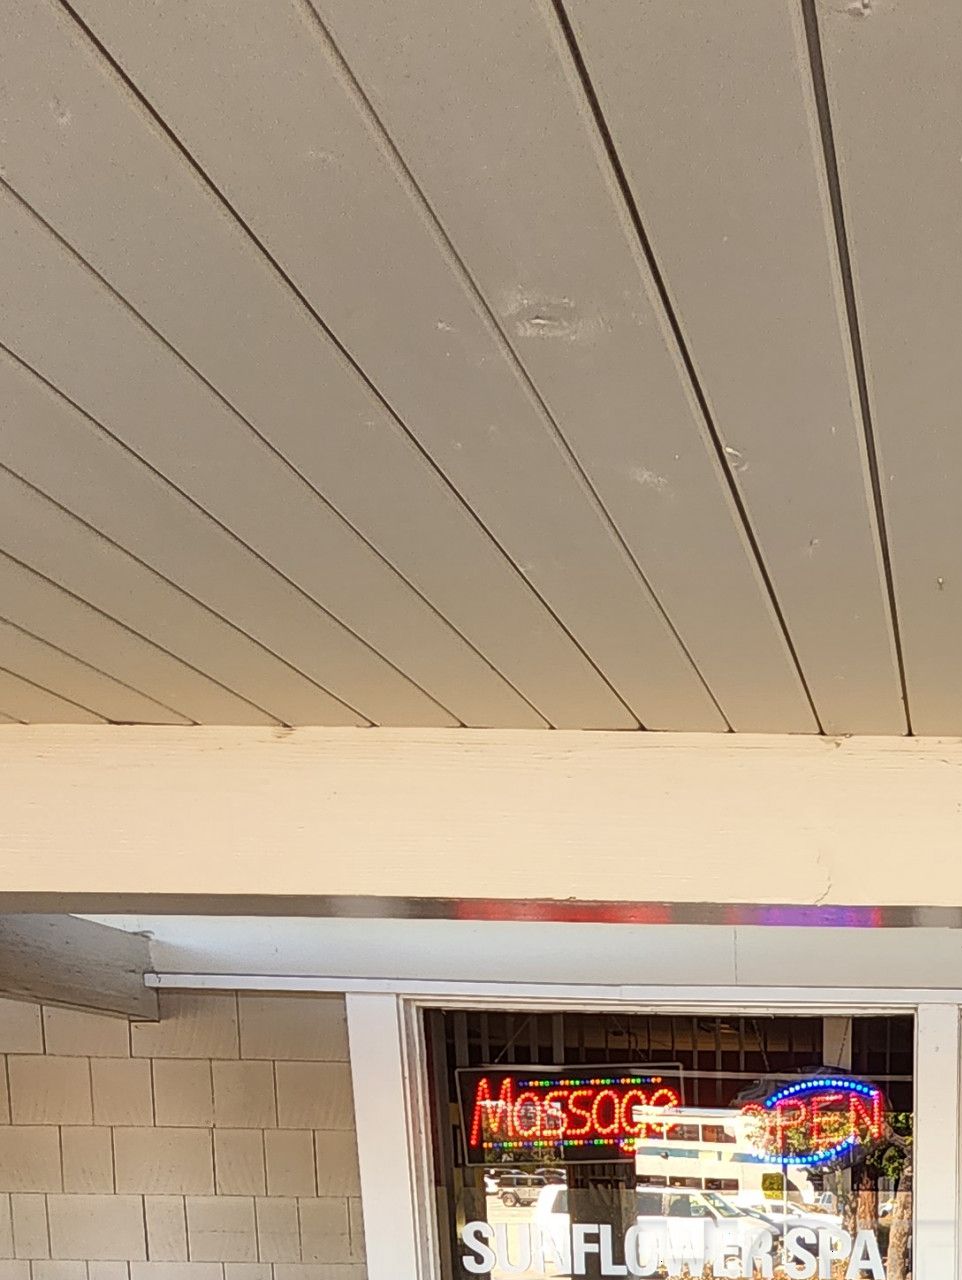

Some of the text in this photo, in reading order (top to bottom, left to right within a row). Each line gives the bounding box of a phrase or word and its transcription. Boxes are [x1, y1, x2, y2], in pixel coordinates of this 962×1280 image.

[470, 1077, 677, 1151] Massage
[741, 1090, 885, 1152] OPEN
[461, 1220, 774, 1278] SUNFLOWER
[783, 1227, 887, 1280] SPA
